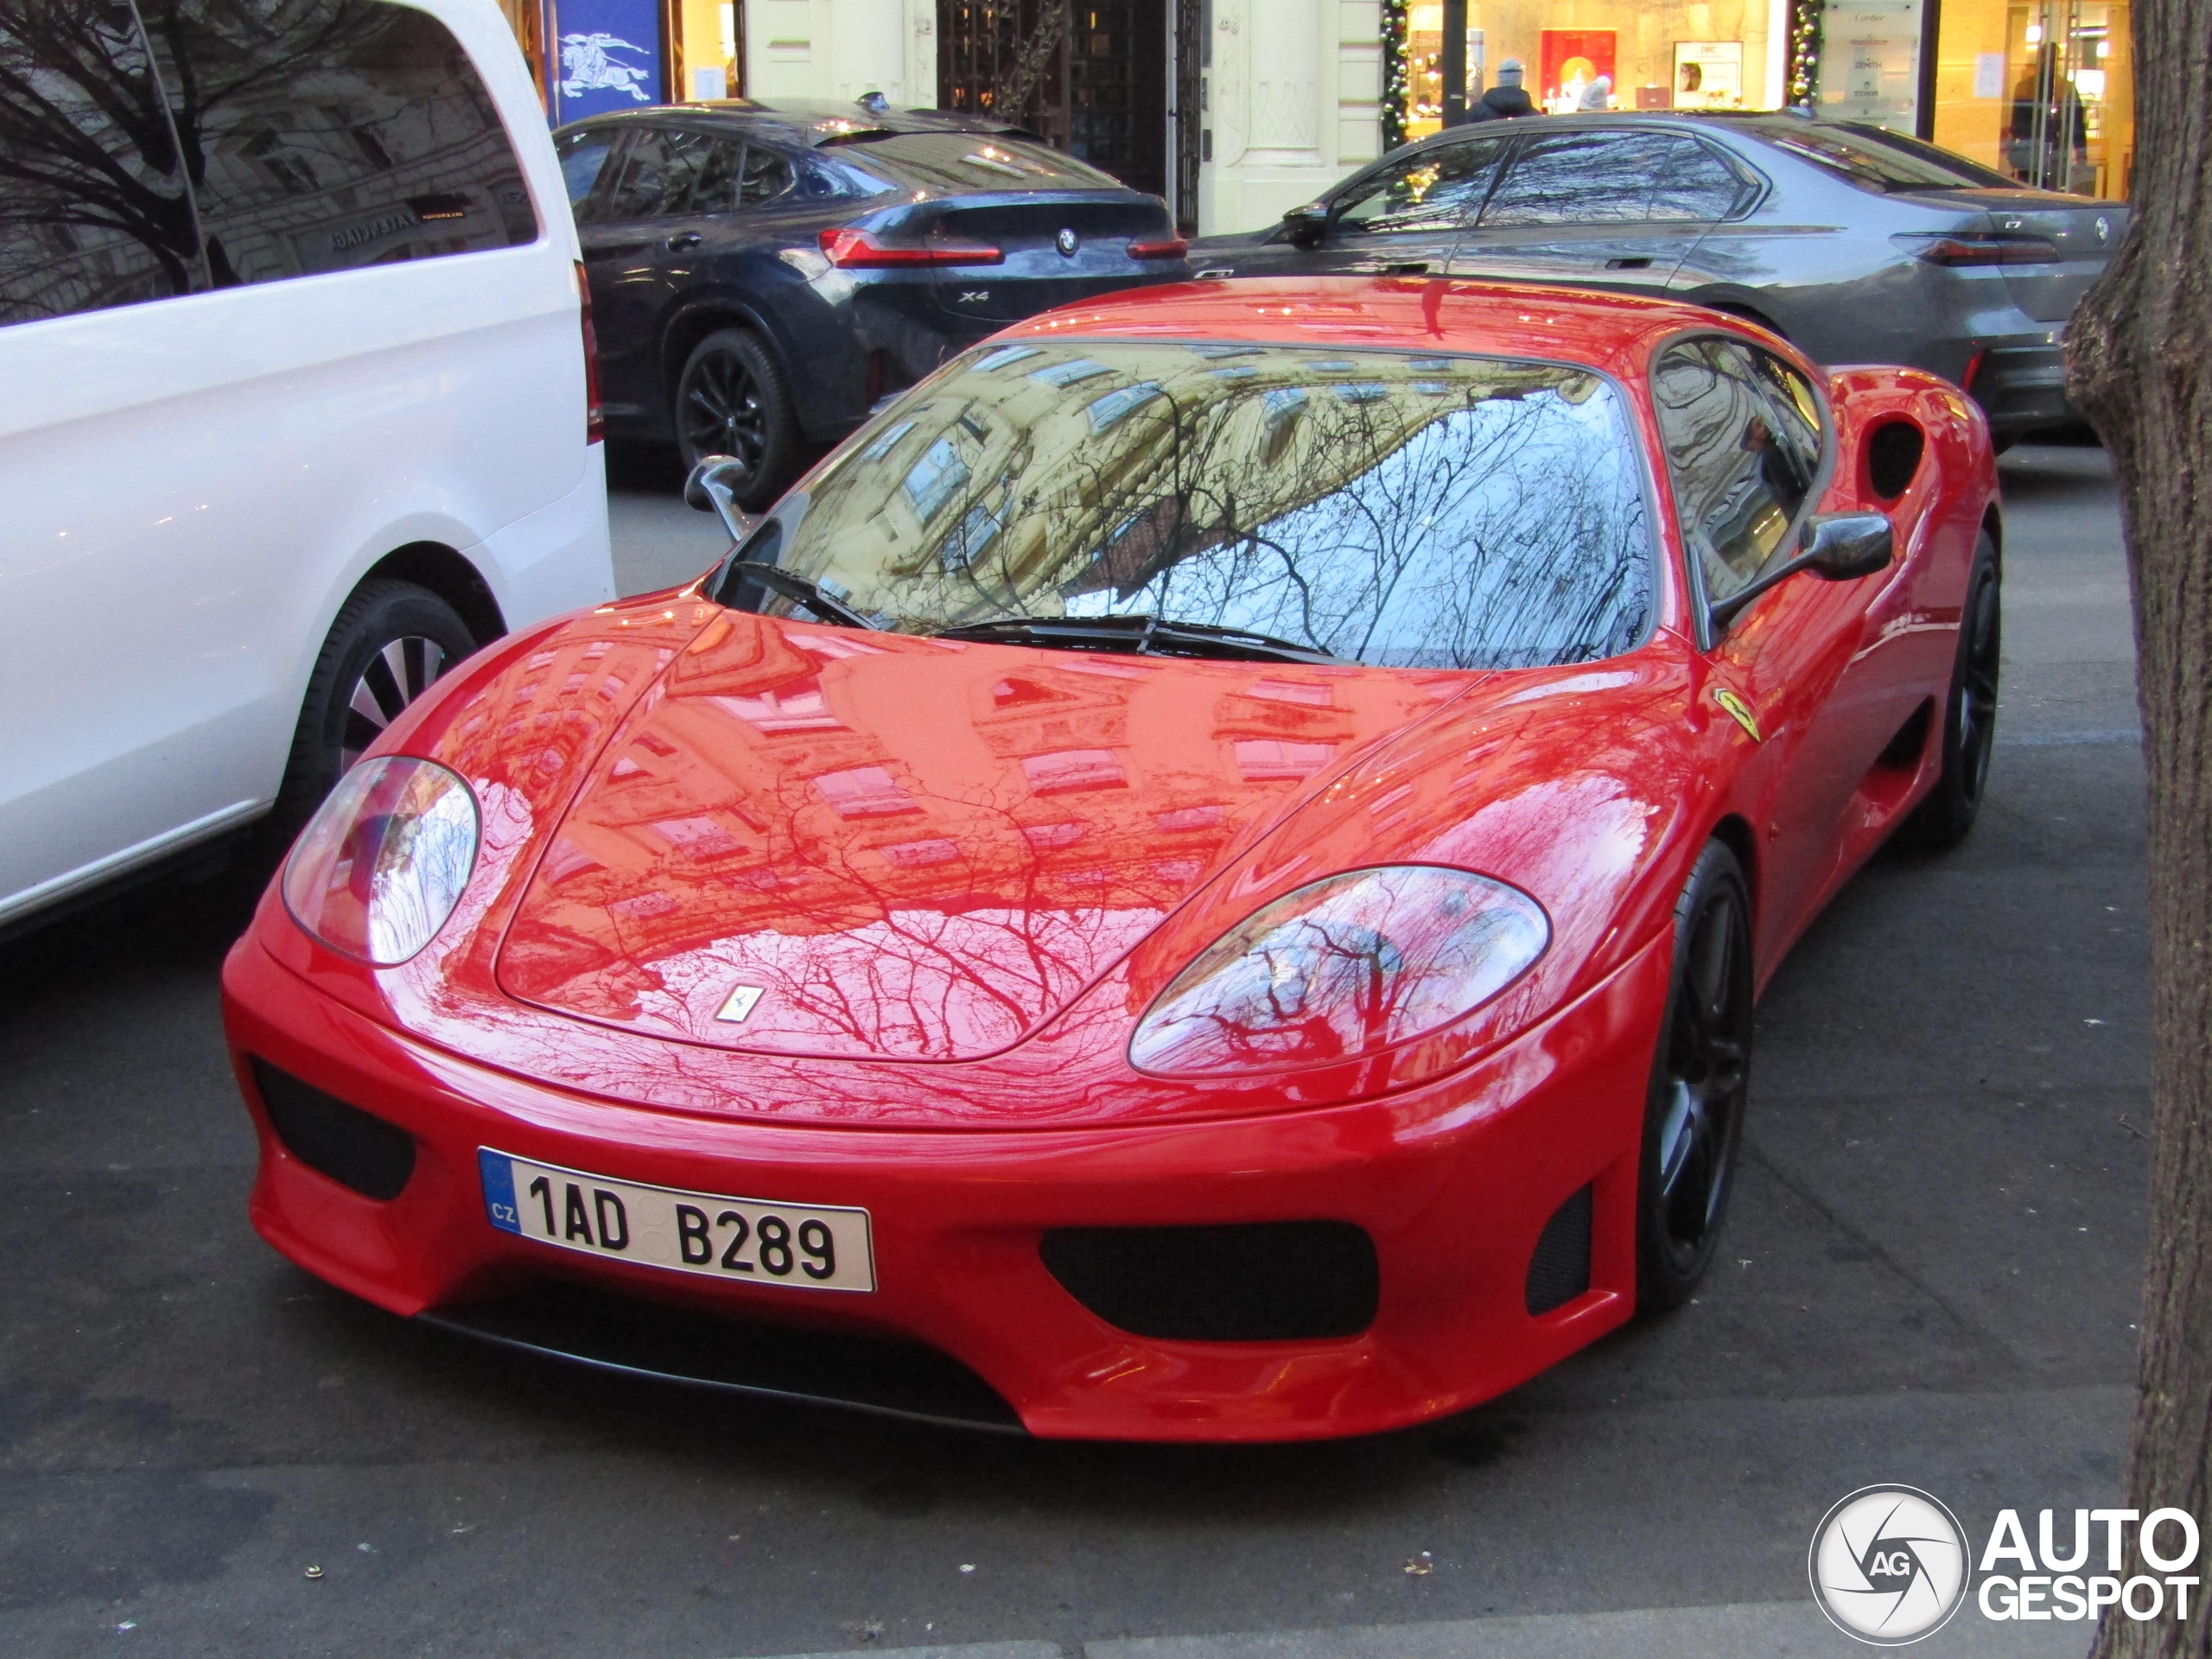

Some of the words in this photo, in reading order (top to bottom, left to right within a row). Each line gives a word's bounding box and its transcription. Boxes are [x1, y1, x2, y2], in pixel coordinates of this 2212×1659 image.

[1415, 38, 1442, 47] ZENIT
[957, 291, 989, 302] X4
[492, 1202, 516, 1224] CZ
[530, 1175, 630, 1251] 1AD
[676, 1203, 836, 1280] B289
